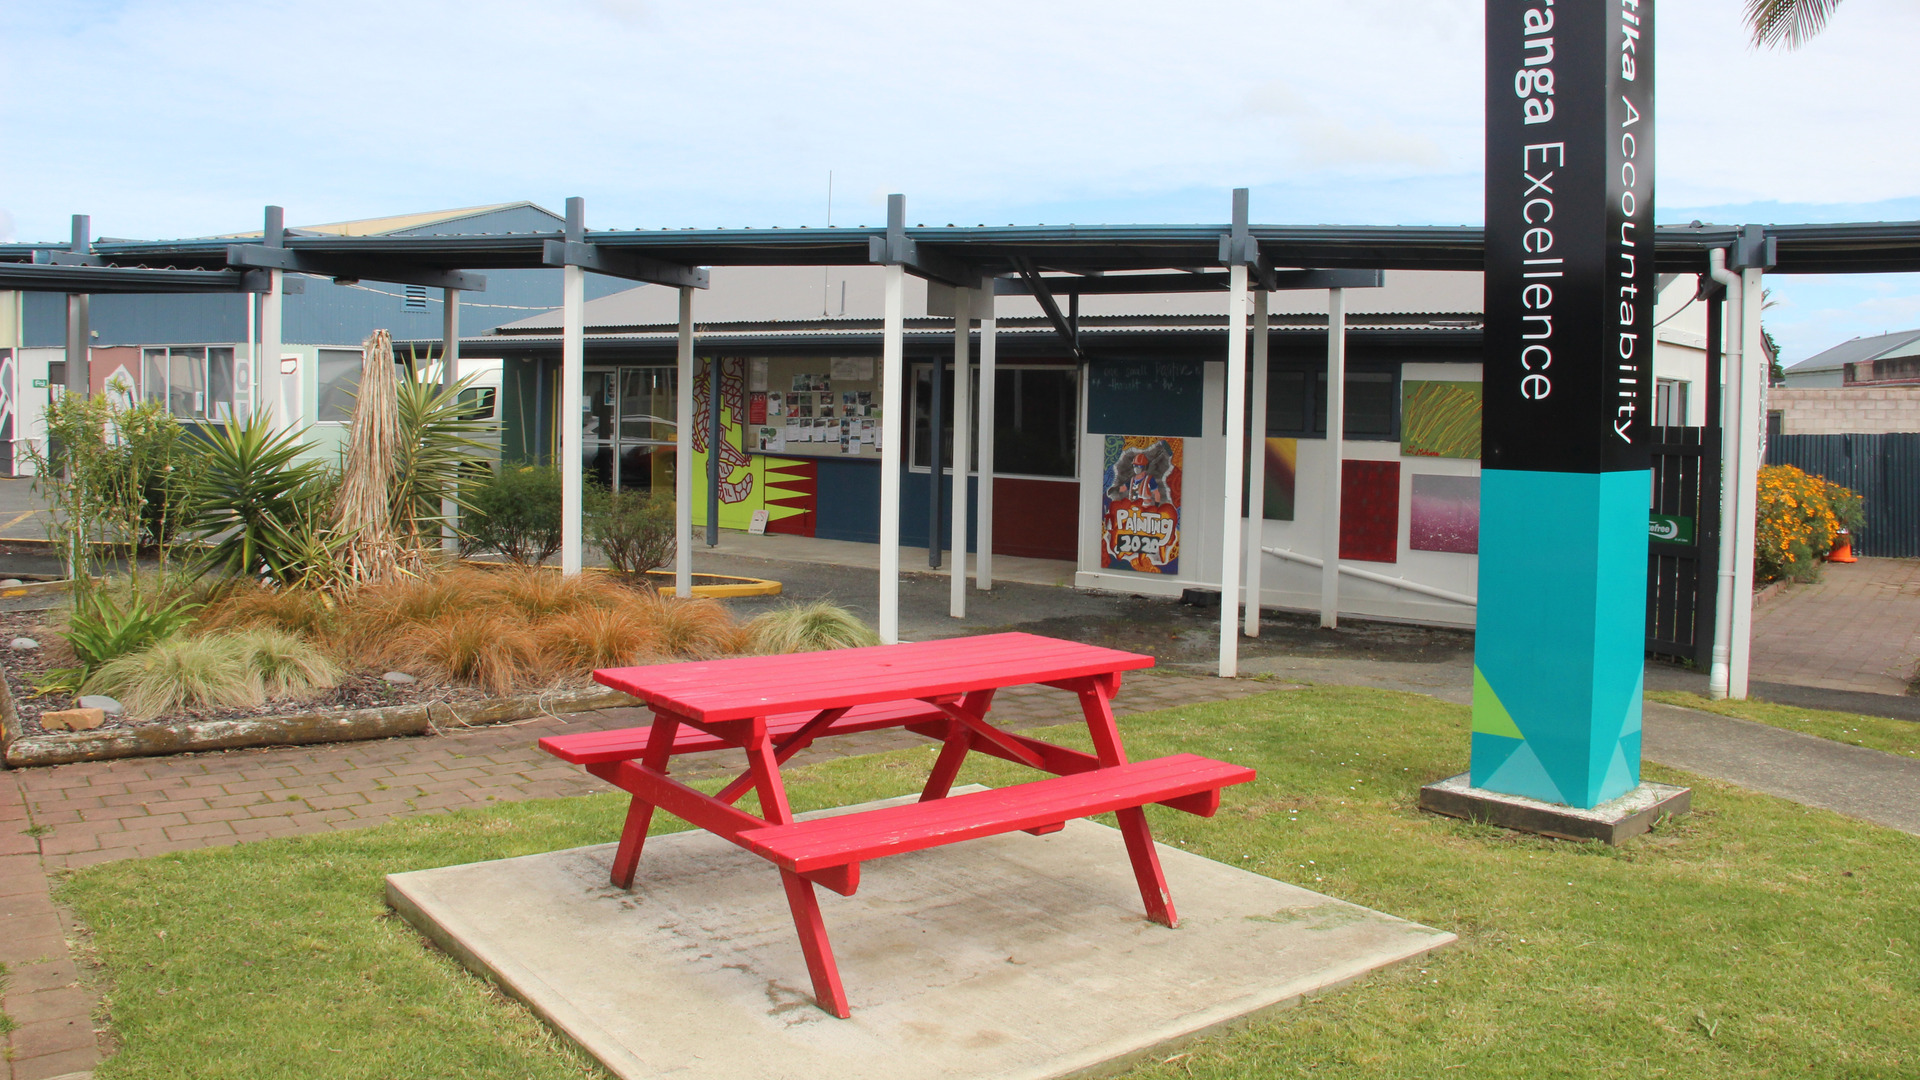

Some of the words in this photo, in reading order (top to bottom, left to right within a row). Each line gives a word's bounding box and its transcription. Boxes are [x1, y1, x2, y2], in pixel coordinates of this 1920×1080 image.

[1521, 141, 1565, 400] Excellence
[1614, 95, 1640, 444] Accountability
[1120, 534, 1160, 554] 2020
[1649, 524, 1670, 533] efree
